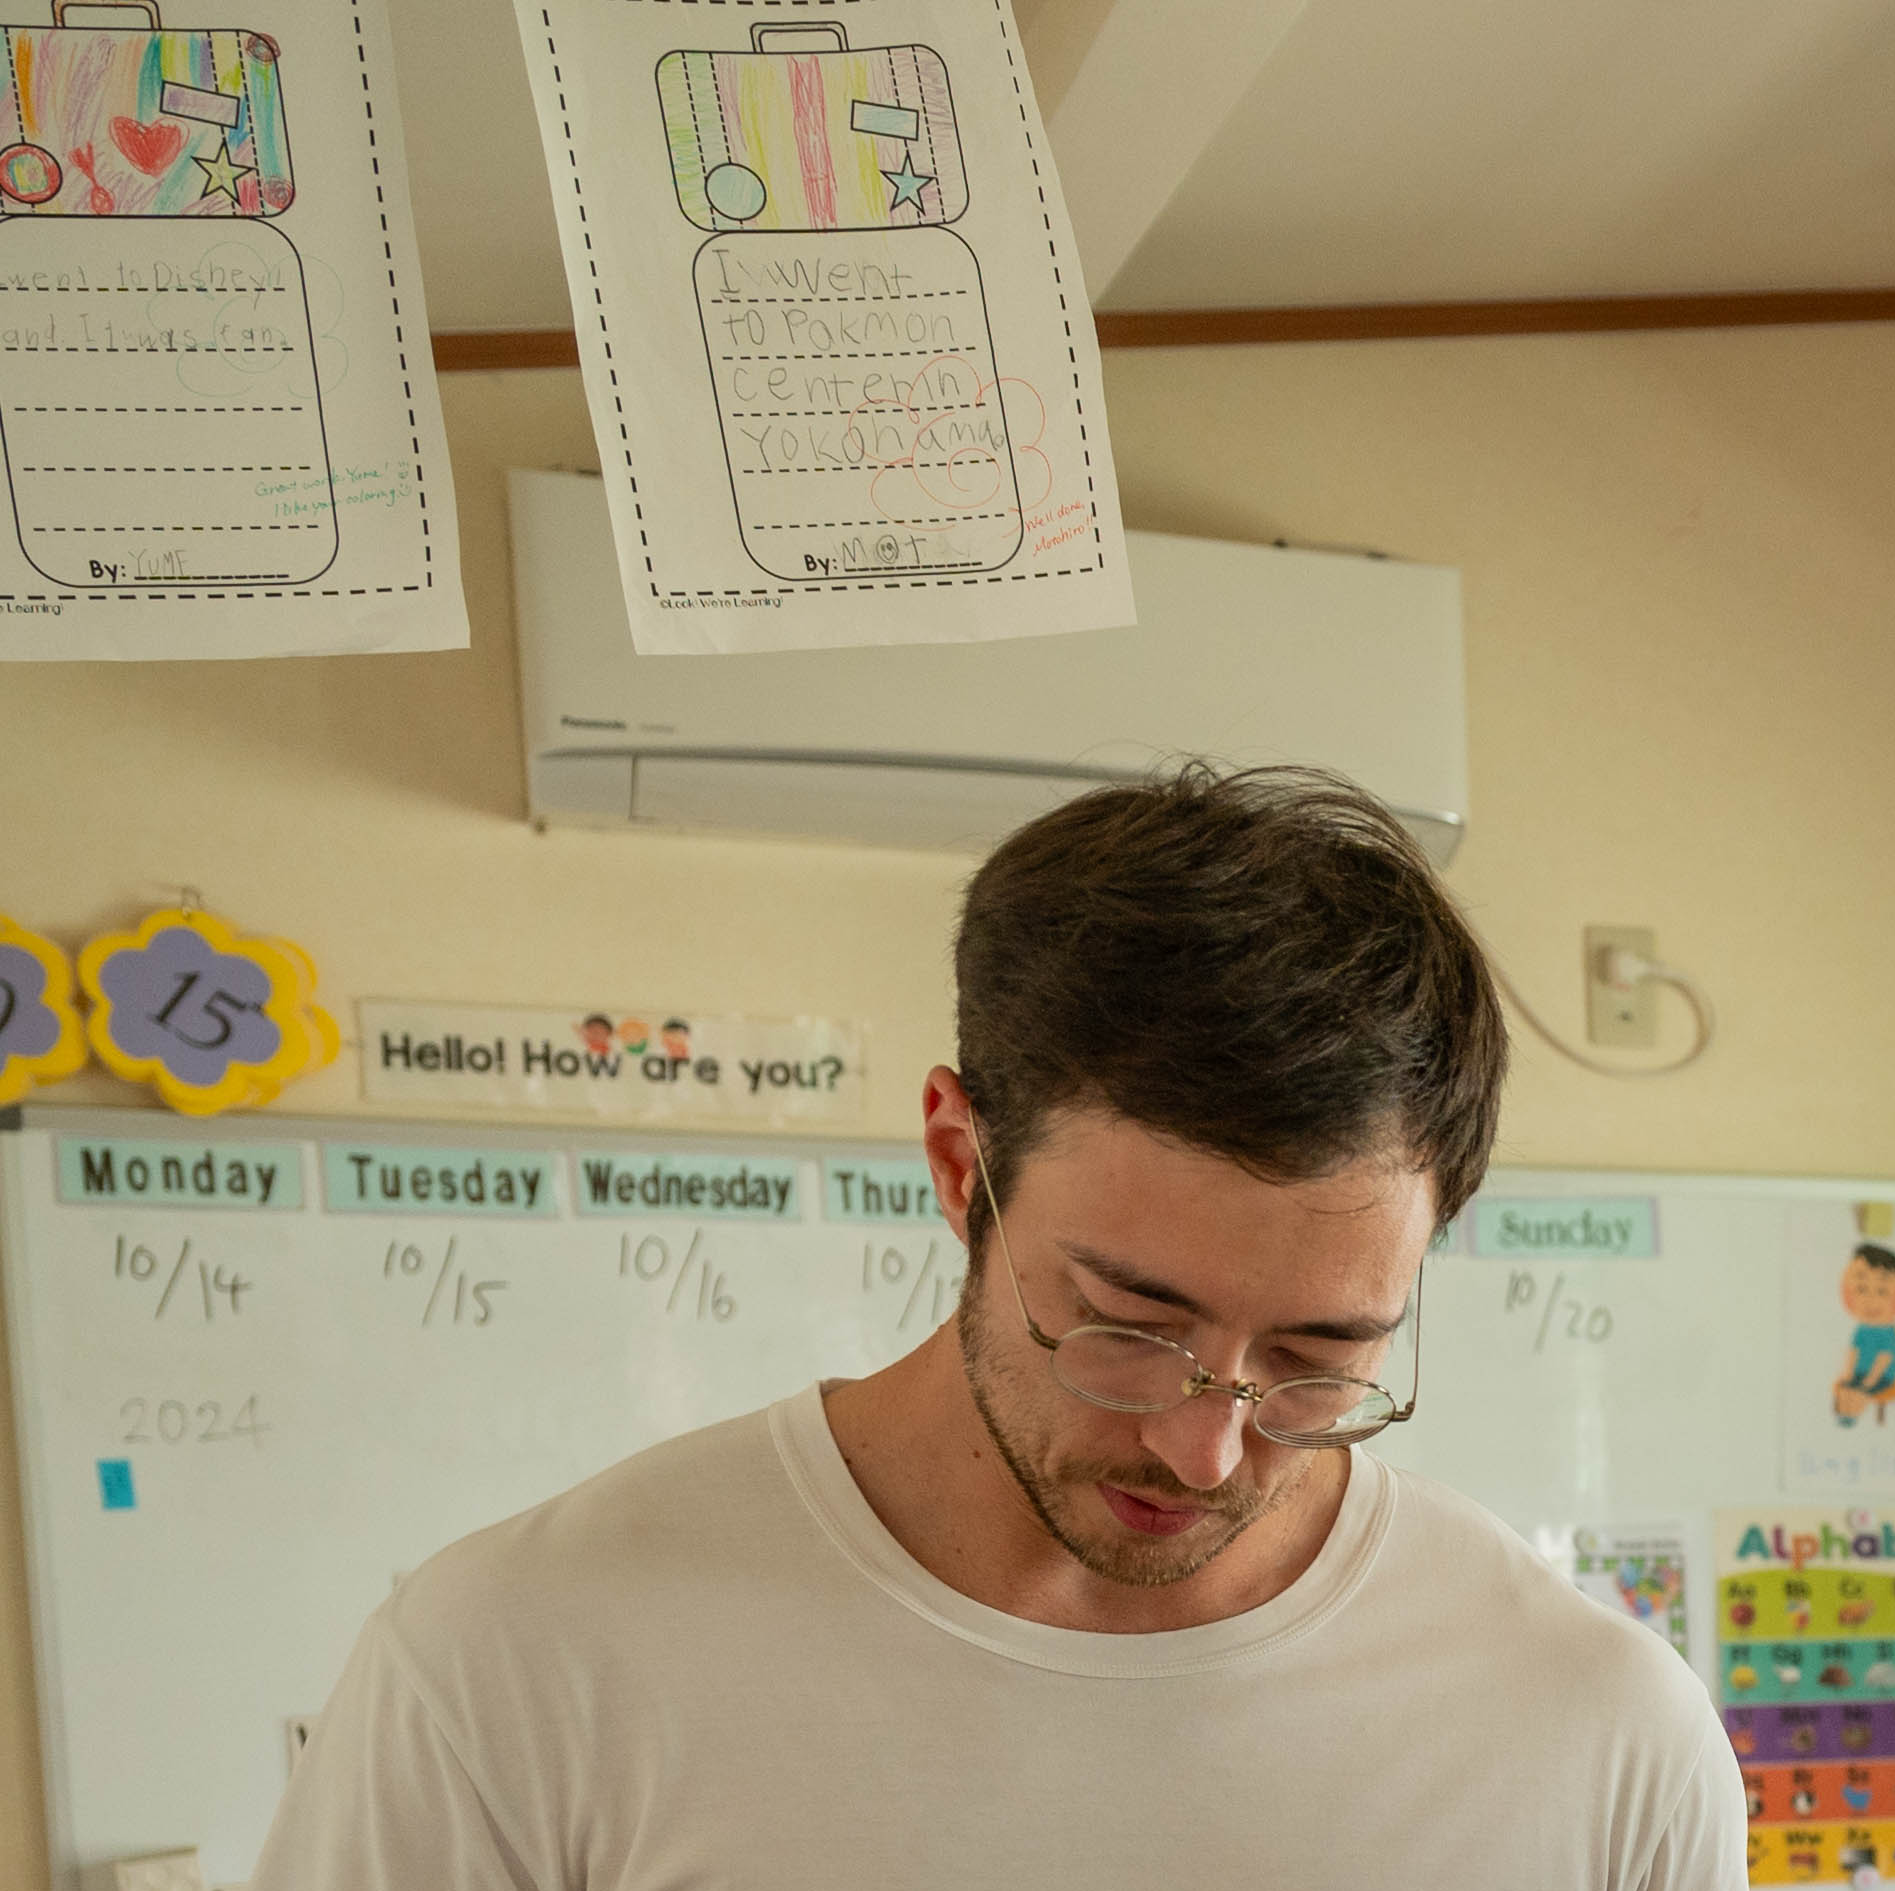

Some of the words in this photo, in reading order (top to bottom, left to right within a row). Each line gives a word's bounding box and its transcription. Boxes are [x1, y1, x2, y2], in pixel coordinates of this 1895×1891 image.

[721, 309, 766, 346] to
[782, 308, 954, 352] Pakmon
[89, 559, 127, 584] By:
[129, 549, 190, 578] YUME
[805, 555, 838, 577] By:
[148, 971, 243, 1052] 15
[380, 1033, 507, 1075] Hello!
[521, 1037, 622, 1082] How
[641, 1052, 720, 1084] are
[741, 1053, 844, 1094] you?
[82, 1150, 278, 1201] Monday
[347, 1157, 542, 1206] Tuesday
[586, 1160, 793, 1213] Wednesday
[1499, 1210, 1637, 1254] Sunday
[115, 1234, 254, 1322] 10/14
[385, 1235, 508, 1327] 10/15
[620, 1228, 737, 1331] 10/16
[1506, 1270, 1614, 1354] 10/20
[122, 1396, 272, 1445] 2024
